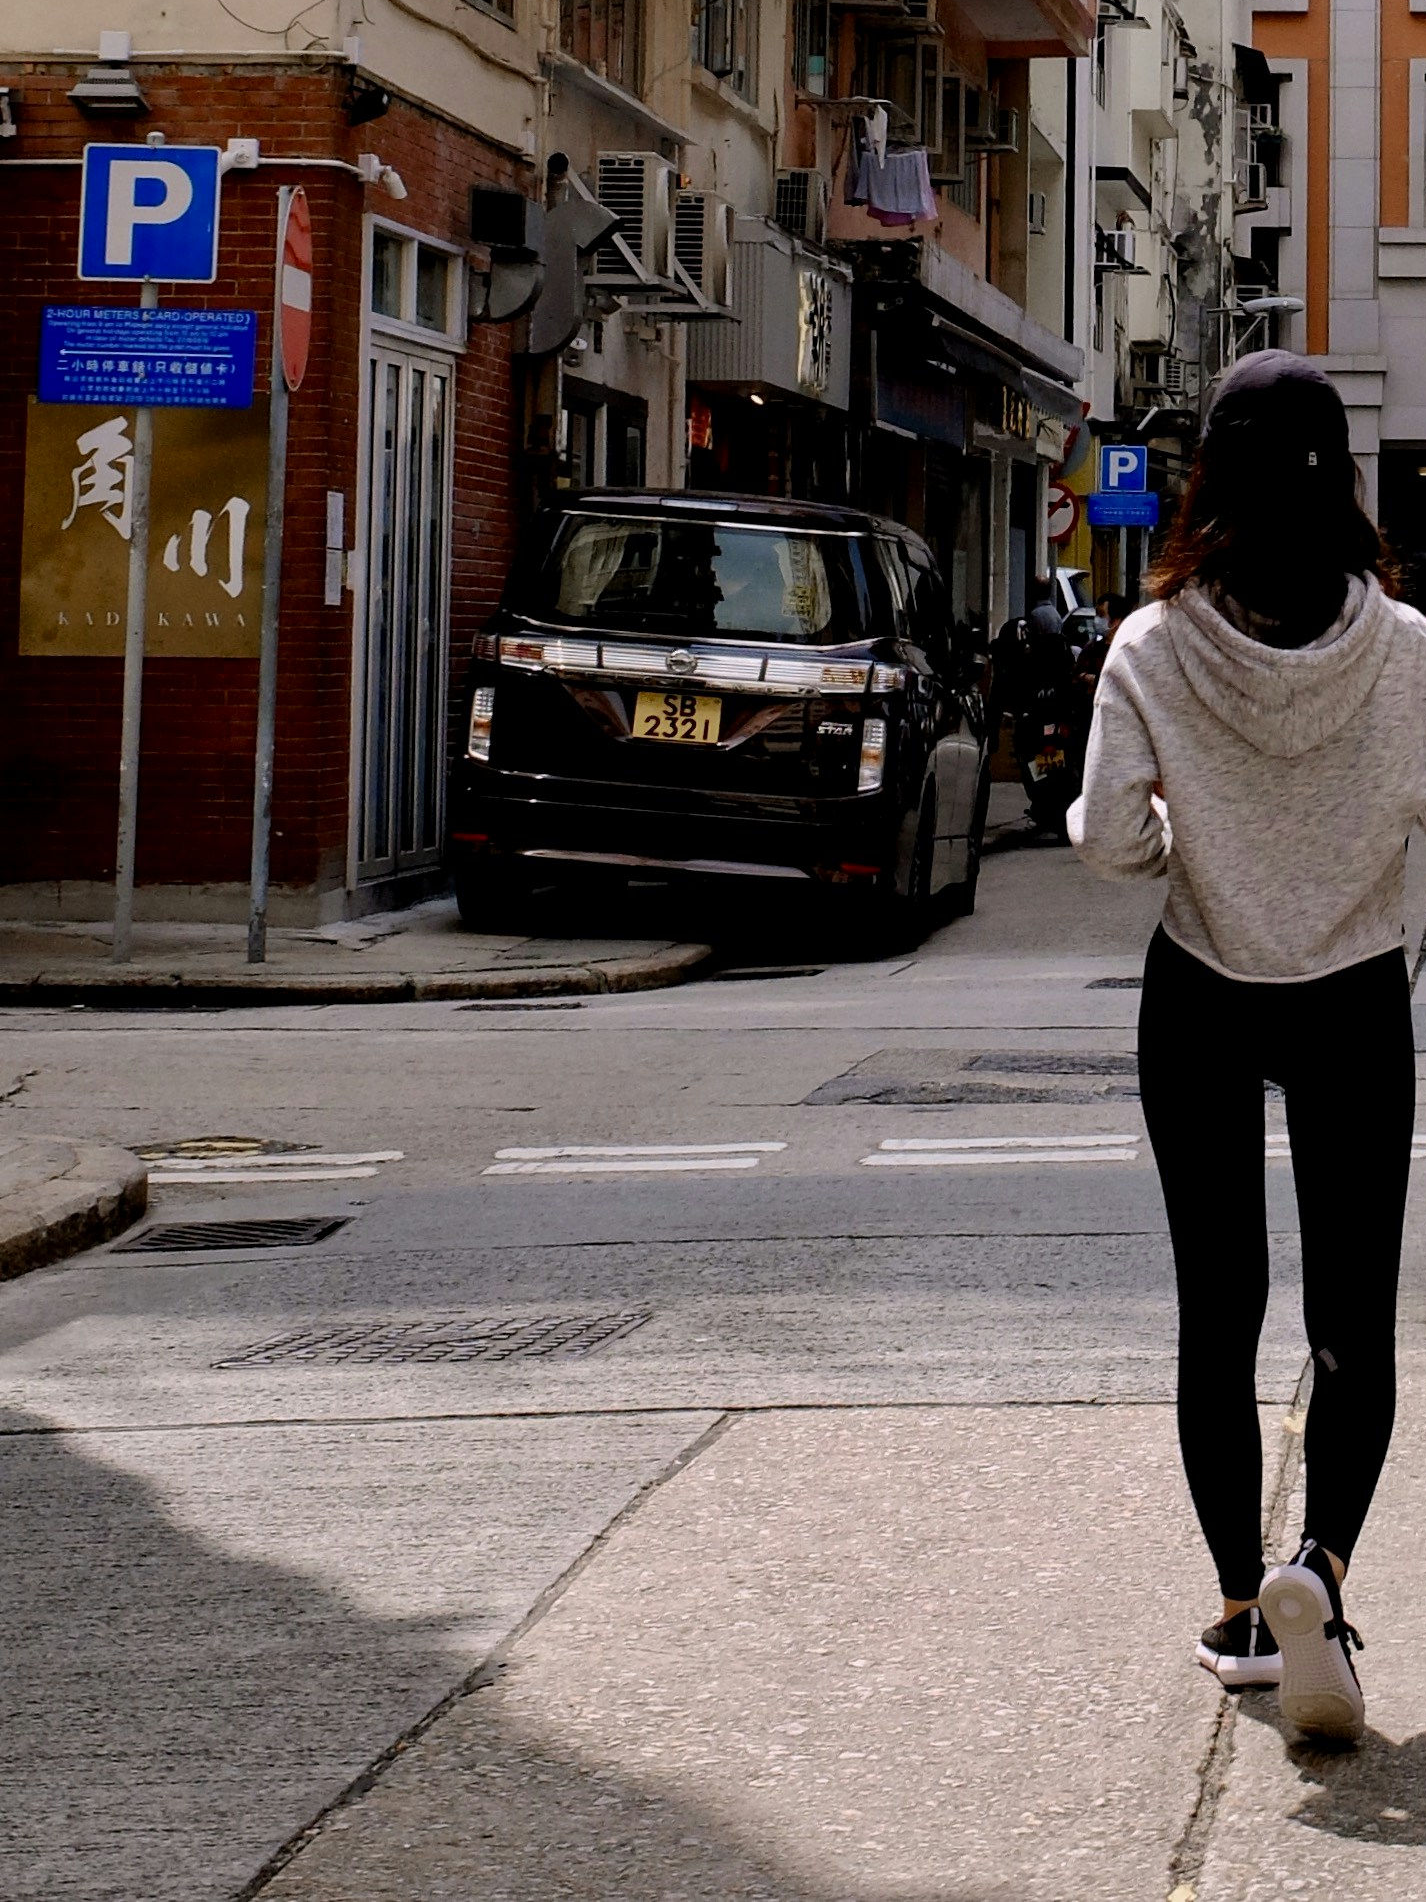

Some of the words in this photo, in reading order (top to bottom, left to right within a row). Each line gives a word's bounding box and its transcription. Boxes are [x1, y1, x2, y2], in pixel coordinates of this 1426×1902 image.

[105, 160, 193, 266] P
[46, 309, 90, 319] 2-HOUR
[94, 310, 139, 320] METERS
[1109, 451, 1138, 487] P
[61, 416, 250, 598] 角川
[58, 611, 246, 627] KADKAWA
[663, 694, 697, 717] SB
[644, 715, 710, 741] 2321
[816, 724, 854, 736] STAR
